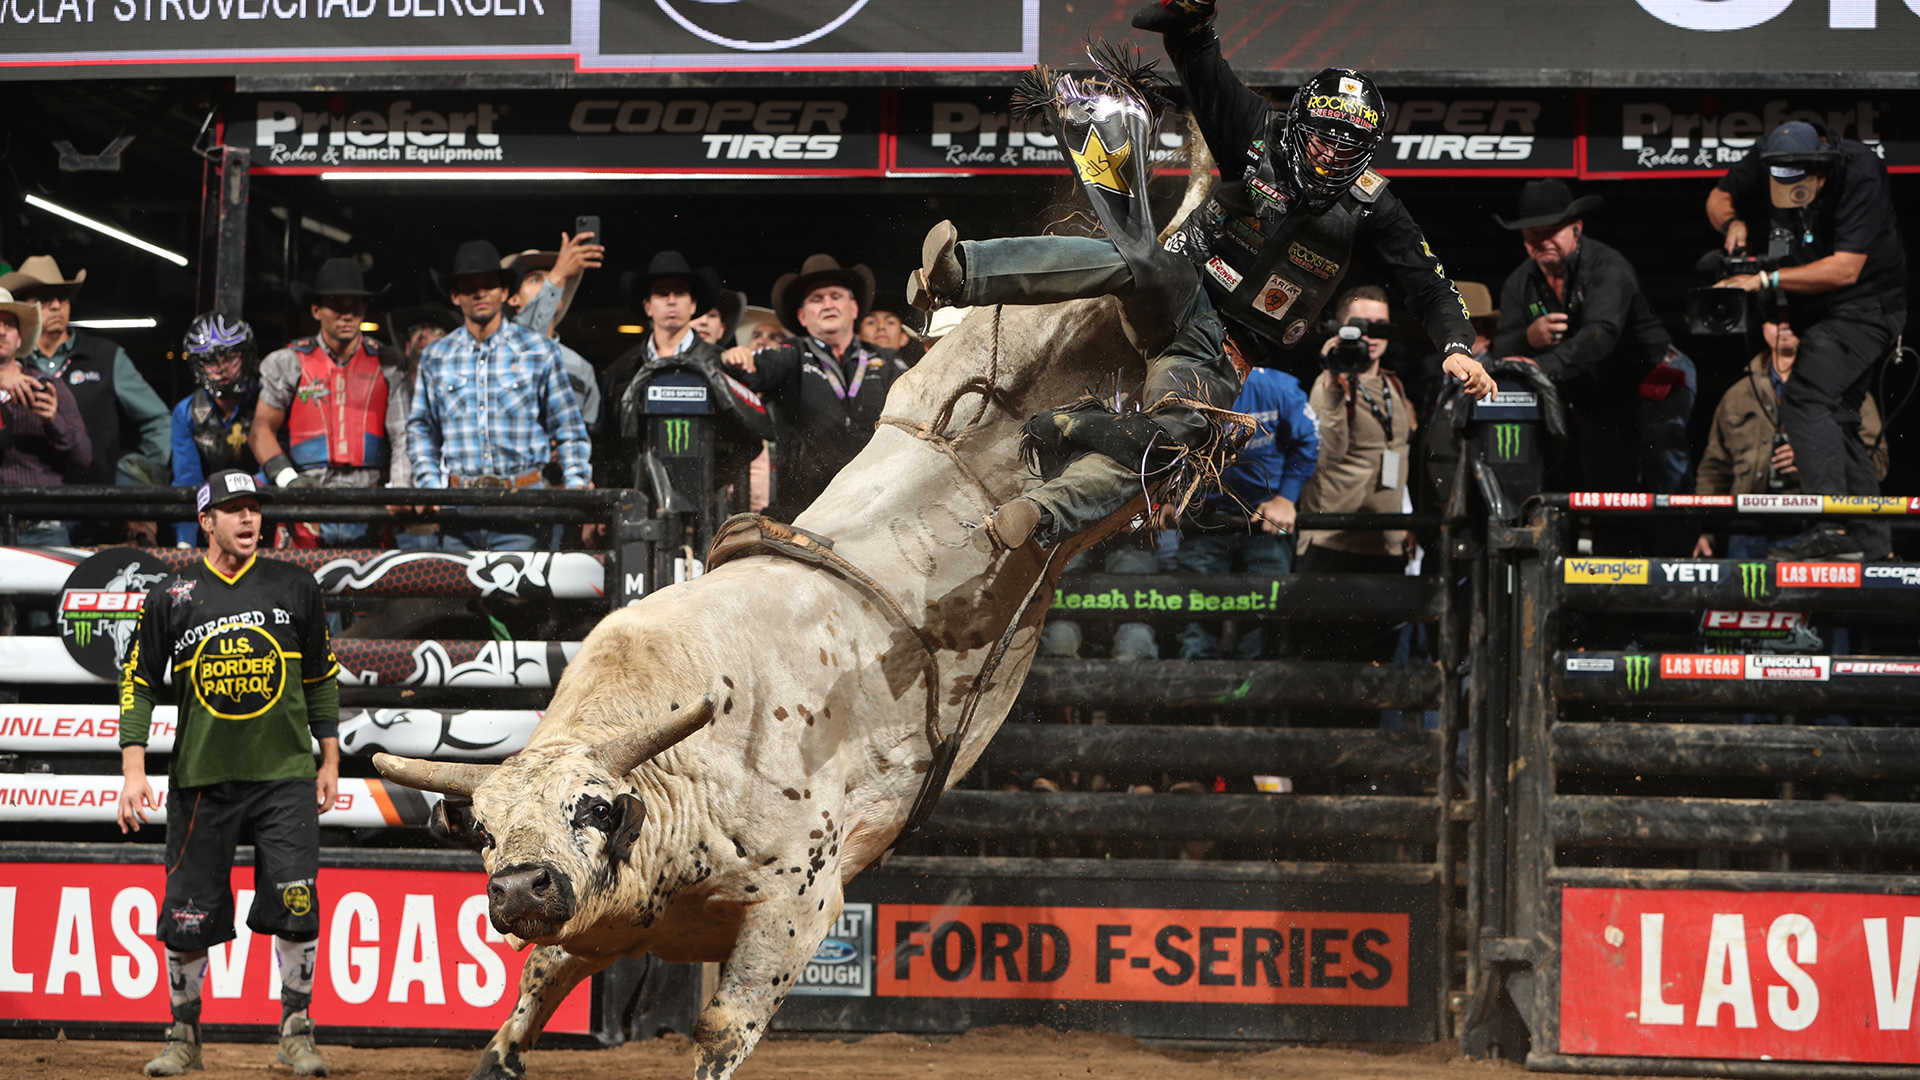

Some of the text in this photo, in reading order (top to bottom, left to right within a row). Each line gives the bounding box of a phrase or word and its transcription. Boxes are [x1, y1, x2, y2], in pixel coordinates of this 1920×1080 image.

[255, 101, 500, 147] Priefert
[568, 101, 849, 133] COOPER
[269, 143, 503, 165] Rodeo & Ranch Equipment
[702, 135, 842, 159] TIRES
[946, 144, 996, 166] Rodeo
[1000, 147, 1018, 166] &
[1392, 135, 1534, 160] TIRES
[1638, 147, 1689, 168] Rodeo
[1694, 149, 1713, 168] &
[1271, 278, 1300, 295] ARIAT
[1574, 492, 1647, 507] LAS VEGAS
[1571, 561, 1642, 581] Wrangler
[1661, 563, 1719, 582] YETI
[1781, 566, 1856, 583] LAS VEGAS
[1050, 581, 1280, 611] leash the Beast!
[1708, 611, 1802, 629] PBR
[219, 637, 254, 655] U.S.
[202, 658, 275, 679] BORDER
[1665, 658, 1740, 675] LAS VEGAS
[204, 676, 273, 697] PATROL
[152, 722, 177, 737] TH
[895, 920, 1392, 990] FORD F-SERIES
[1639, 913, 1820, 1031] LAS
